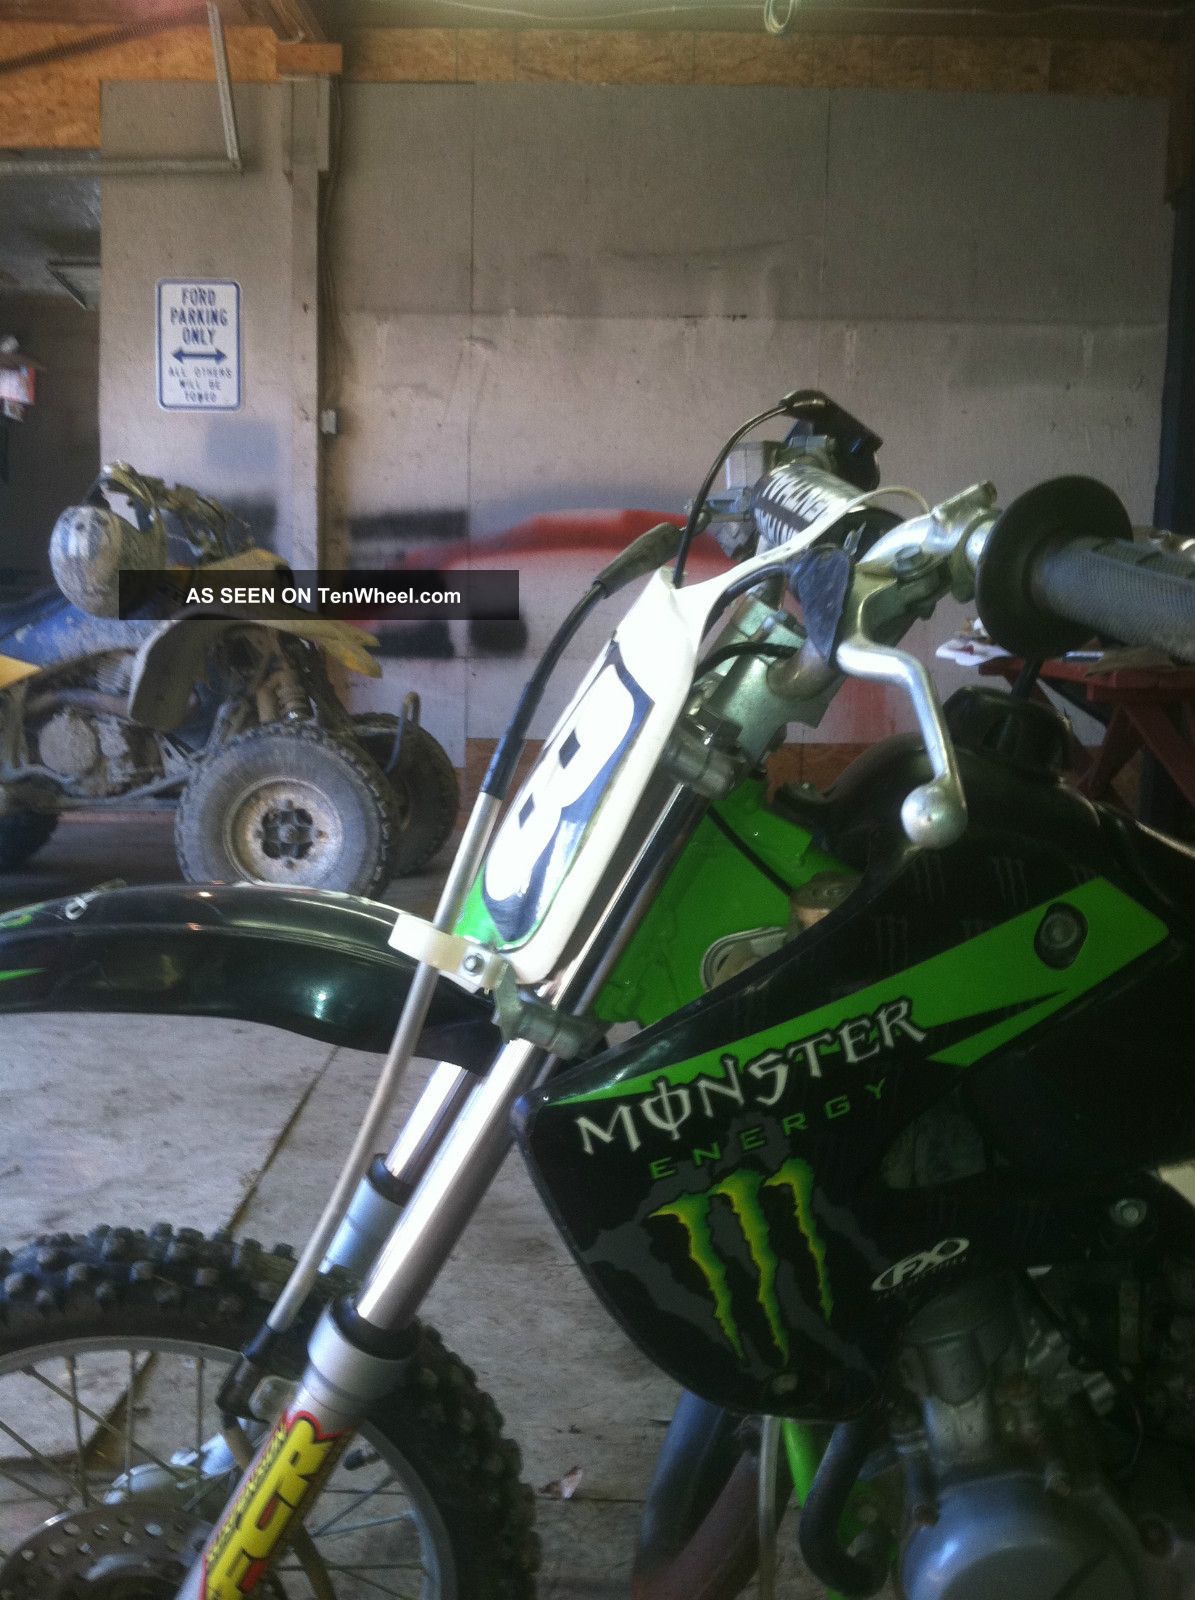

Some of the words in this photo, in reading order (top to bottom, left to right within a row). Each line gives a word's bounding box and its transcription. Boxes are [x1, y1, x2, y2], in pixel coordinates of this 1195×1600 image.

[181, 287, 216, 306] FORD
[170, 307, 228, 326] PARKING
[182, 327, 215, 345] ONLY
[168, 366, 187, 377] ALL
[194, 367, 232, 378] OTHERS
[184, 391, 217, 402] TOWED
[575, 999, 927, 1155] MONSTER
[649, 1077, 887, 1180] ENERGY
